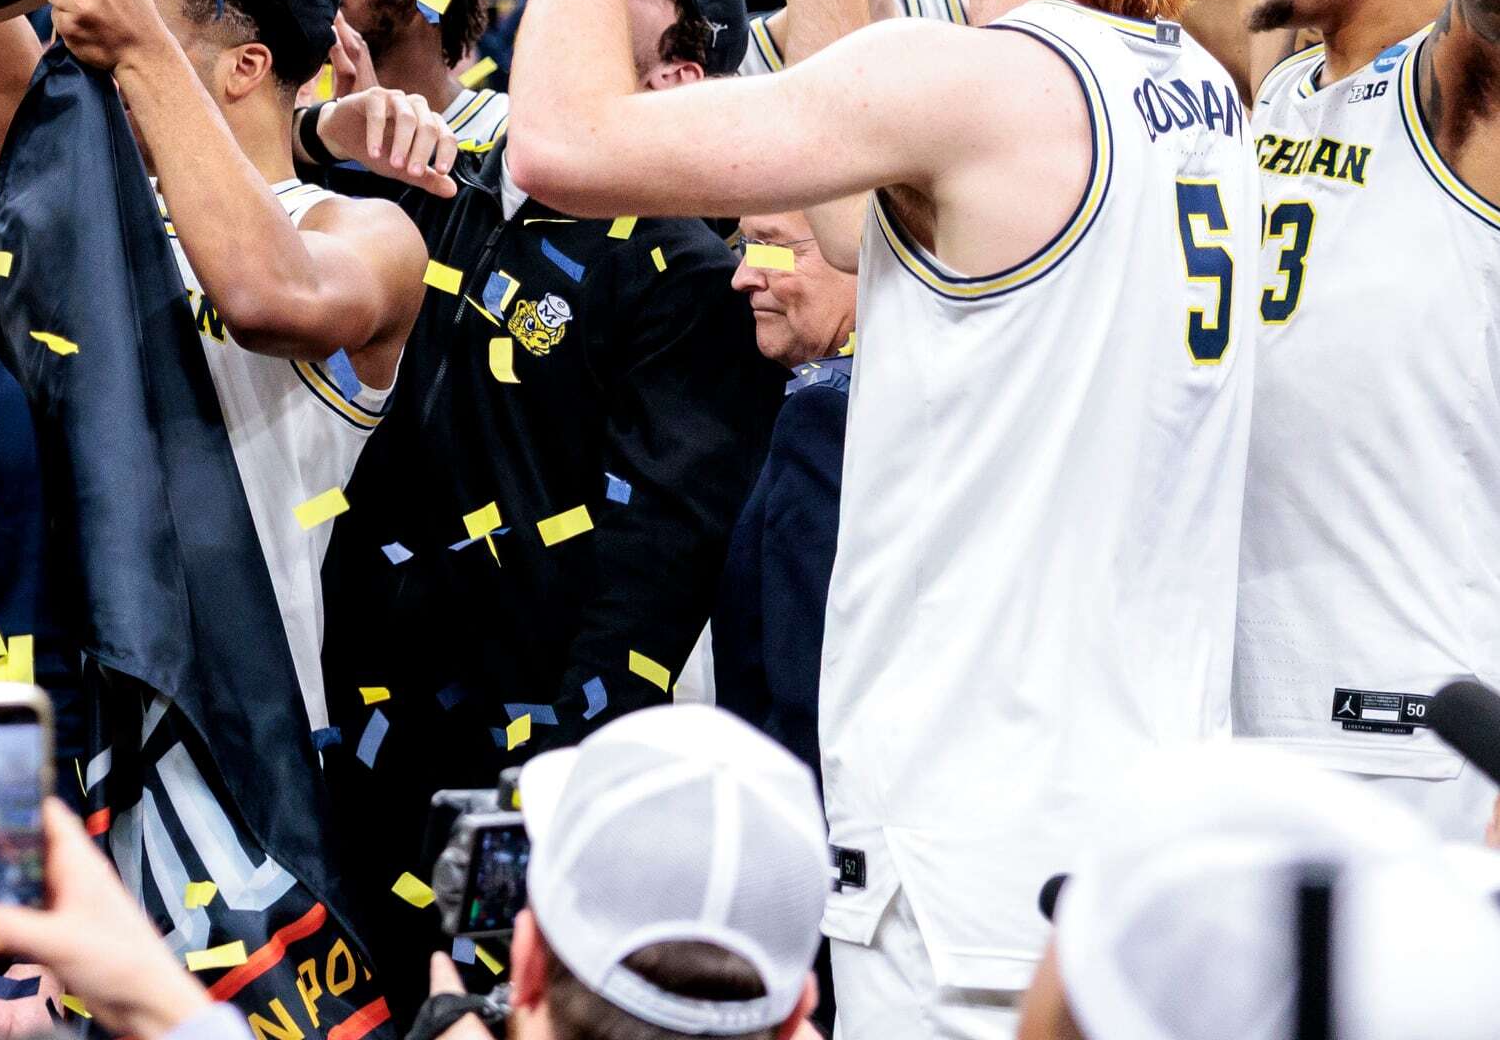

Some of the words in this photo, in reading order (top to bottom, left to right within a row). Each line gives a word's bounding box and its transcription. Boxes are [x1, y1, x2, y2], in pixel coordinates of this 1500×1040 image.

[1175, 177, 1235, 366] 5
[1406, 702, 1426, 718] 50
[844, 857, 856, 876] 52
